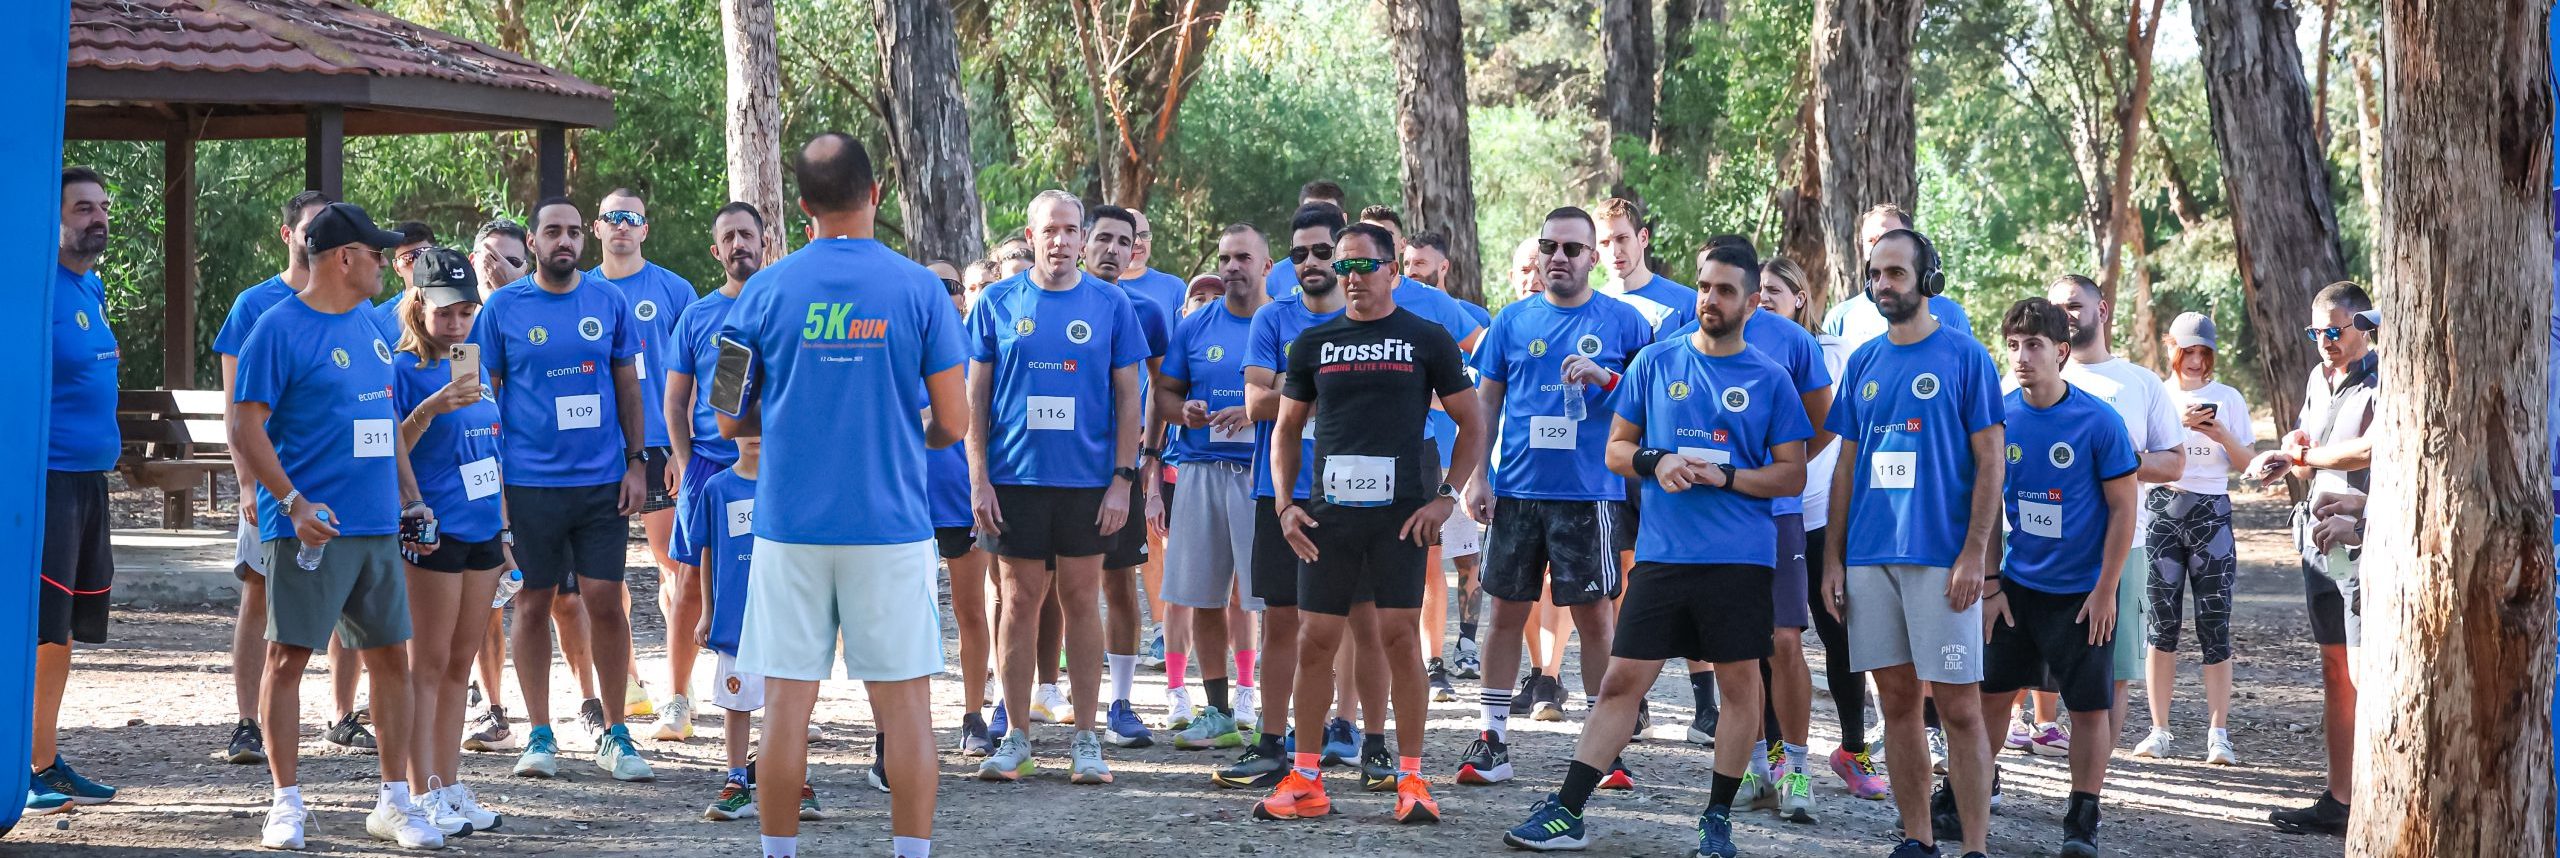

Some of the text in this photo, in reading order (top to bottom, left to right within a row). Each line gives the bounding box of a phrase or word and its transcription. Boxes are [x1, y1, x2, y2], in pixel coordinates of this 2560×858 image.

[803, 302, 889, 340] 5K RUN
[1320, 338, 1413, 365] CrossFit
[546, 361, 594, 378] ecommbx
[1028, 360, 1077, 372] ecommbx
[1353, 362, 1377, 372] ELITE
[1379, 362, 1414, 373] FITNESS
[1212, 389, 1244, 397] ecomm
[566, 406, 593, 418] 109
[1037, 408, 1066, 419] 116
[1873, 418, 1921, 434] ecommbx
[364, 432, 388, 444] 311
[1538, 427, 1567, 438] 129
[1676, 428, 1728, 444] ecommbx
[2187, 446, 2211, 456] 133
[1880, 464, 1906, 476] 118
[473, 470, 496, 486] 312
[1345, 478, 1377, 490] 122
[2017, 489, 2062, 502] ecommbx
[737, 511, 753, 524] 30
[2027, 513, 2053, 526] 146
